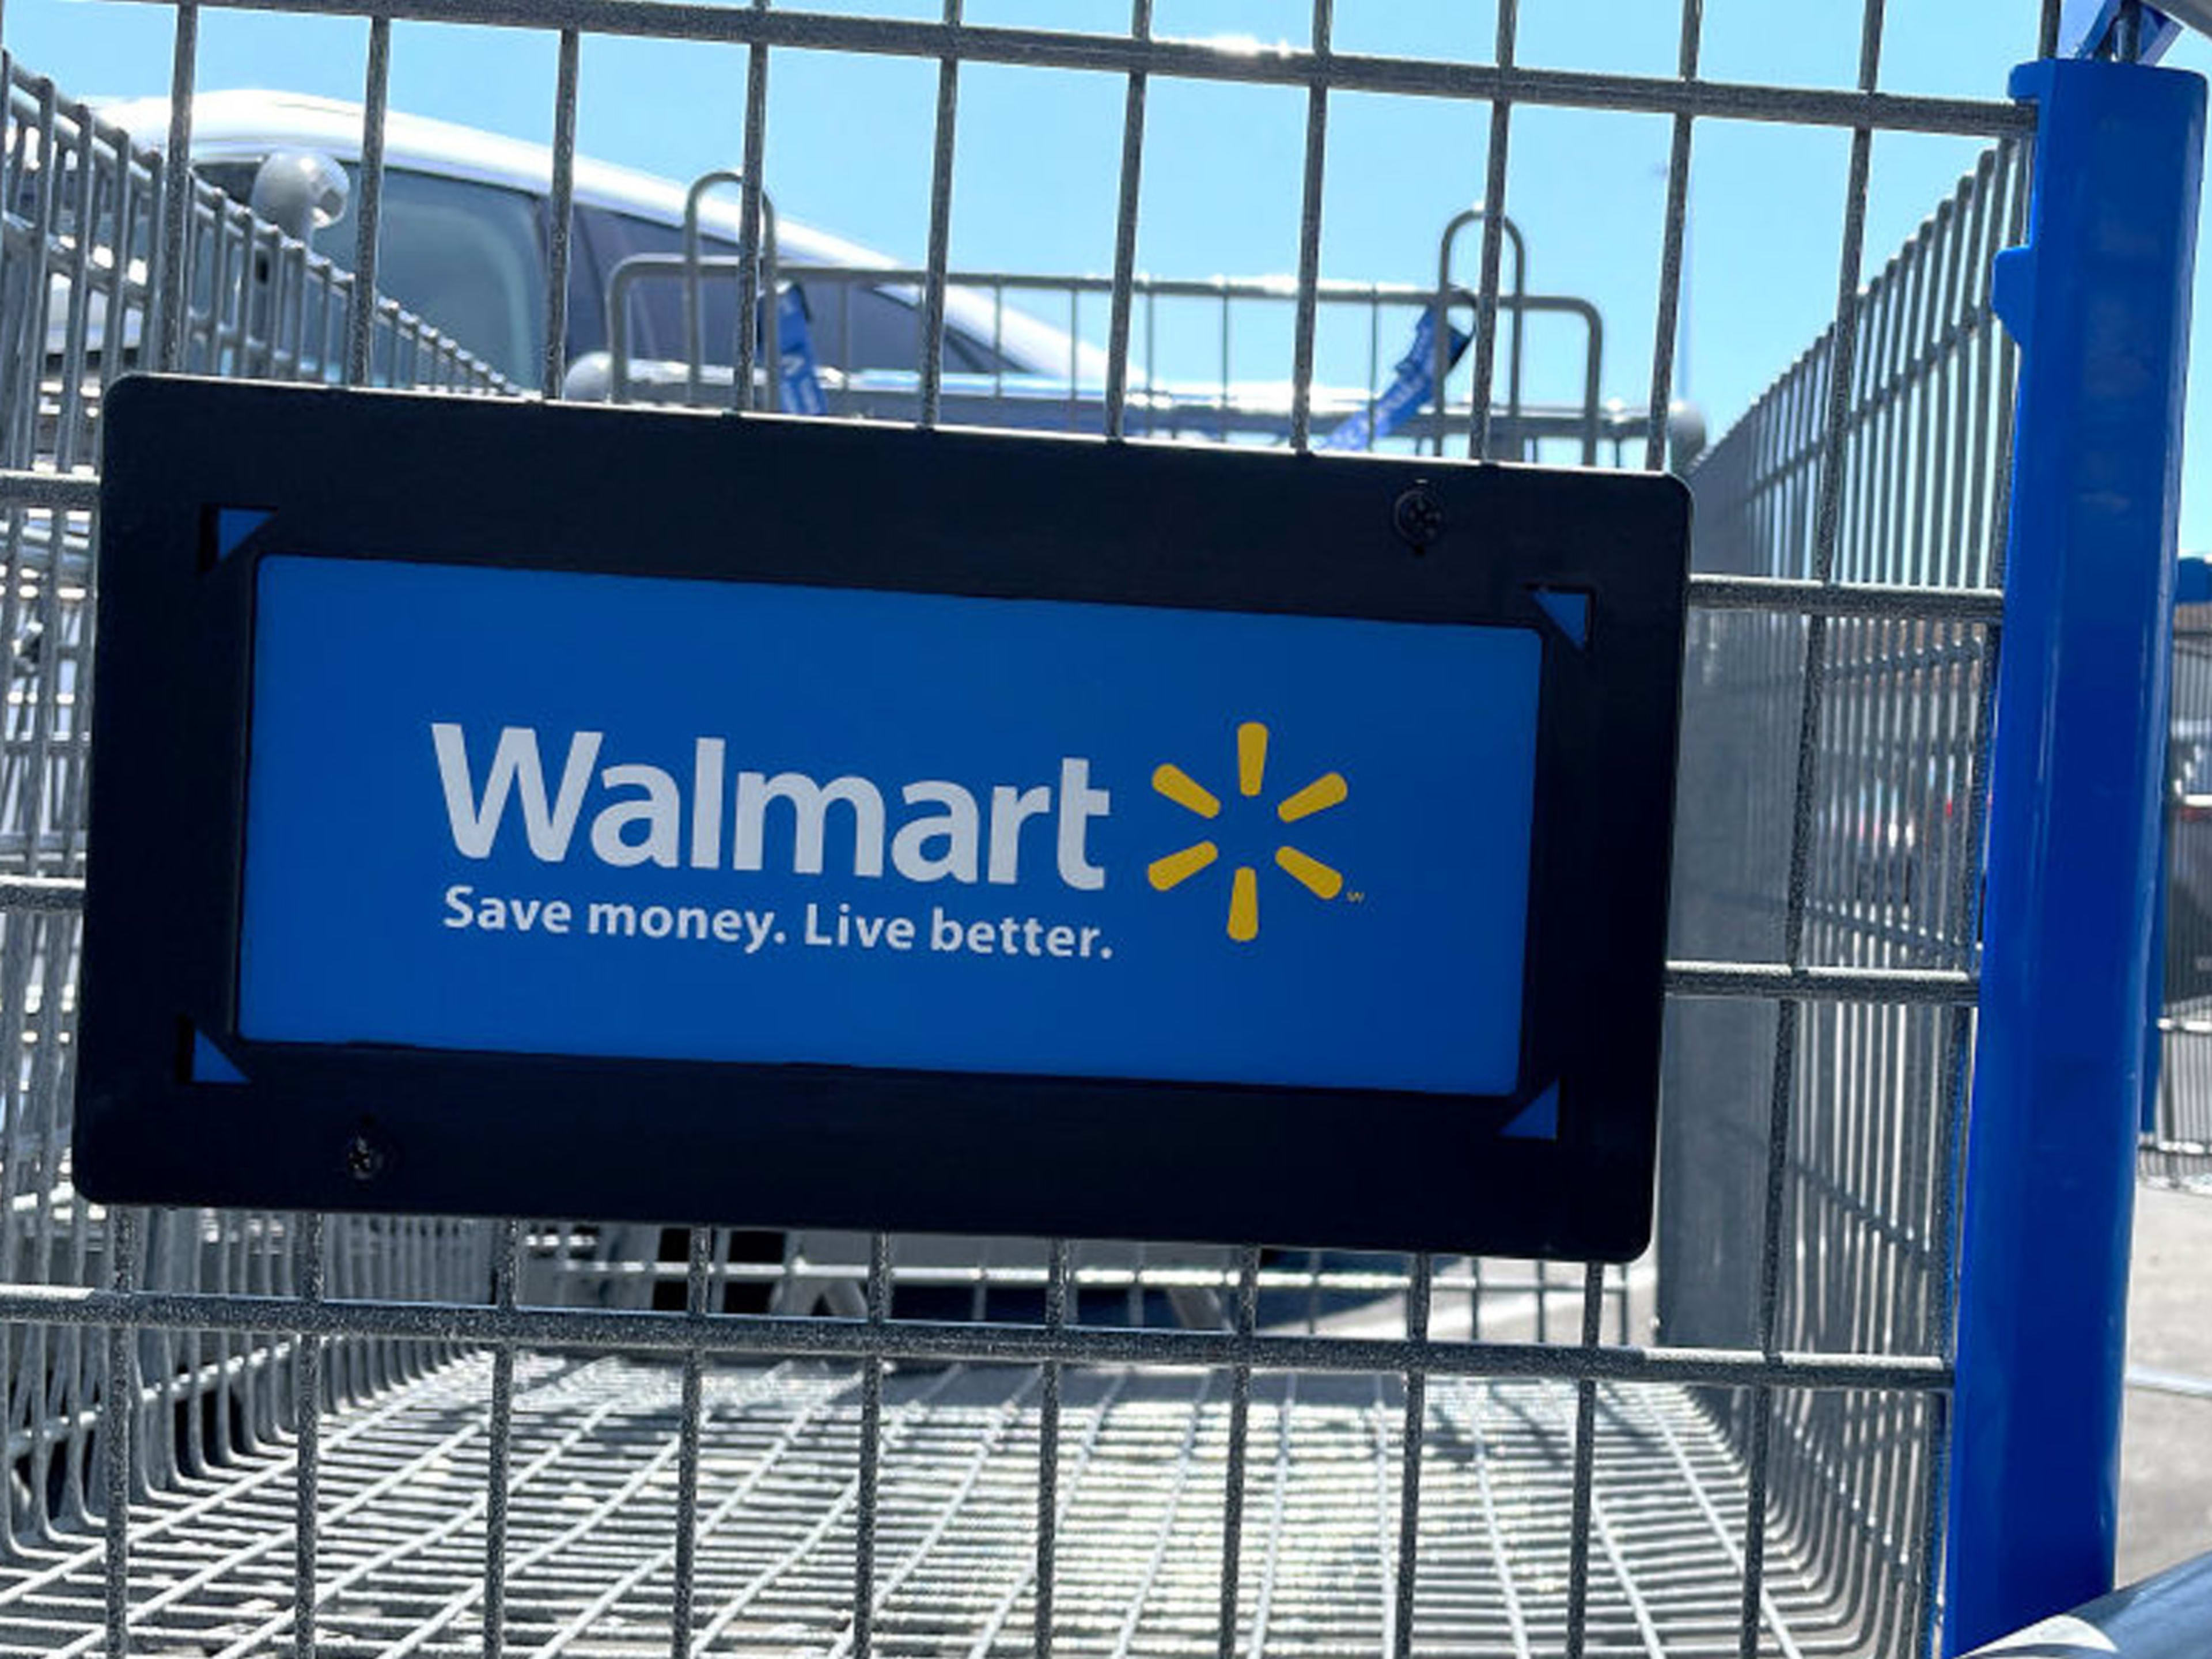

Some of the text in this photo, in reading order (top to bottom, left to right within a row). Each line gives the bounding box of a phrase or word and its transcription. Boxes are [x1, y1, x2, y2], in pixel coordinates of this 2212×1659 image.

[431, 722, 1110, 891] Walmart
[444, 885, 1112, 959] Save money. Live better.
